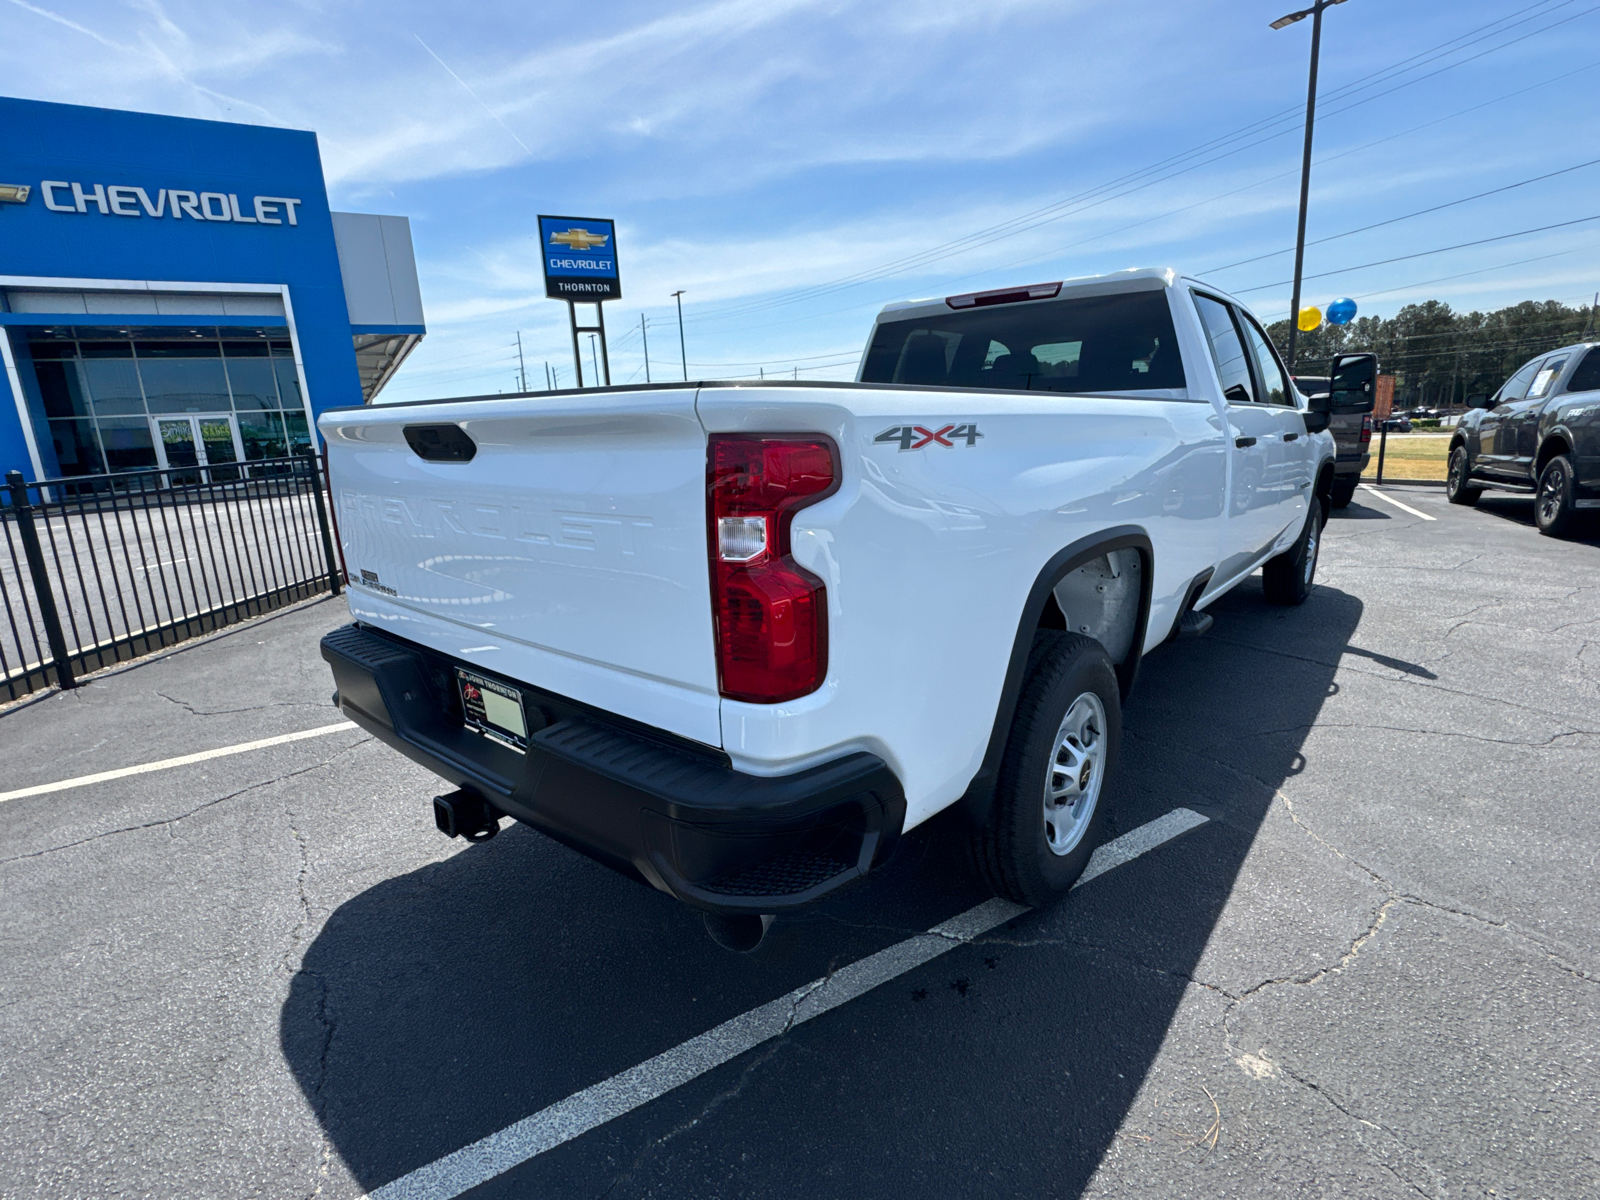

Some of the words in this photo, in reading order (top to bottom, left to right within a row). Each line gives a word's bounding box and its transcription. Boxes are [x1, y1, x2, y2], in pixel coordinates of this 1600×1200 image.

[41, 180, 301, 226] CHEVROLET
[550, 258, 612, 270] CHEVROLET
[558, 282, 610, 292] THORNTON
[873, 423, 984, 452] 4X4
[340, 489, 654, 556] CHEVROLET
